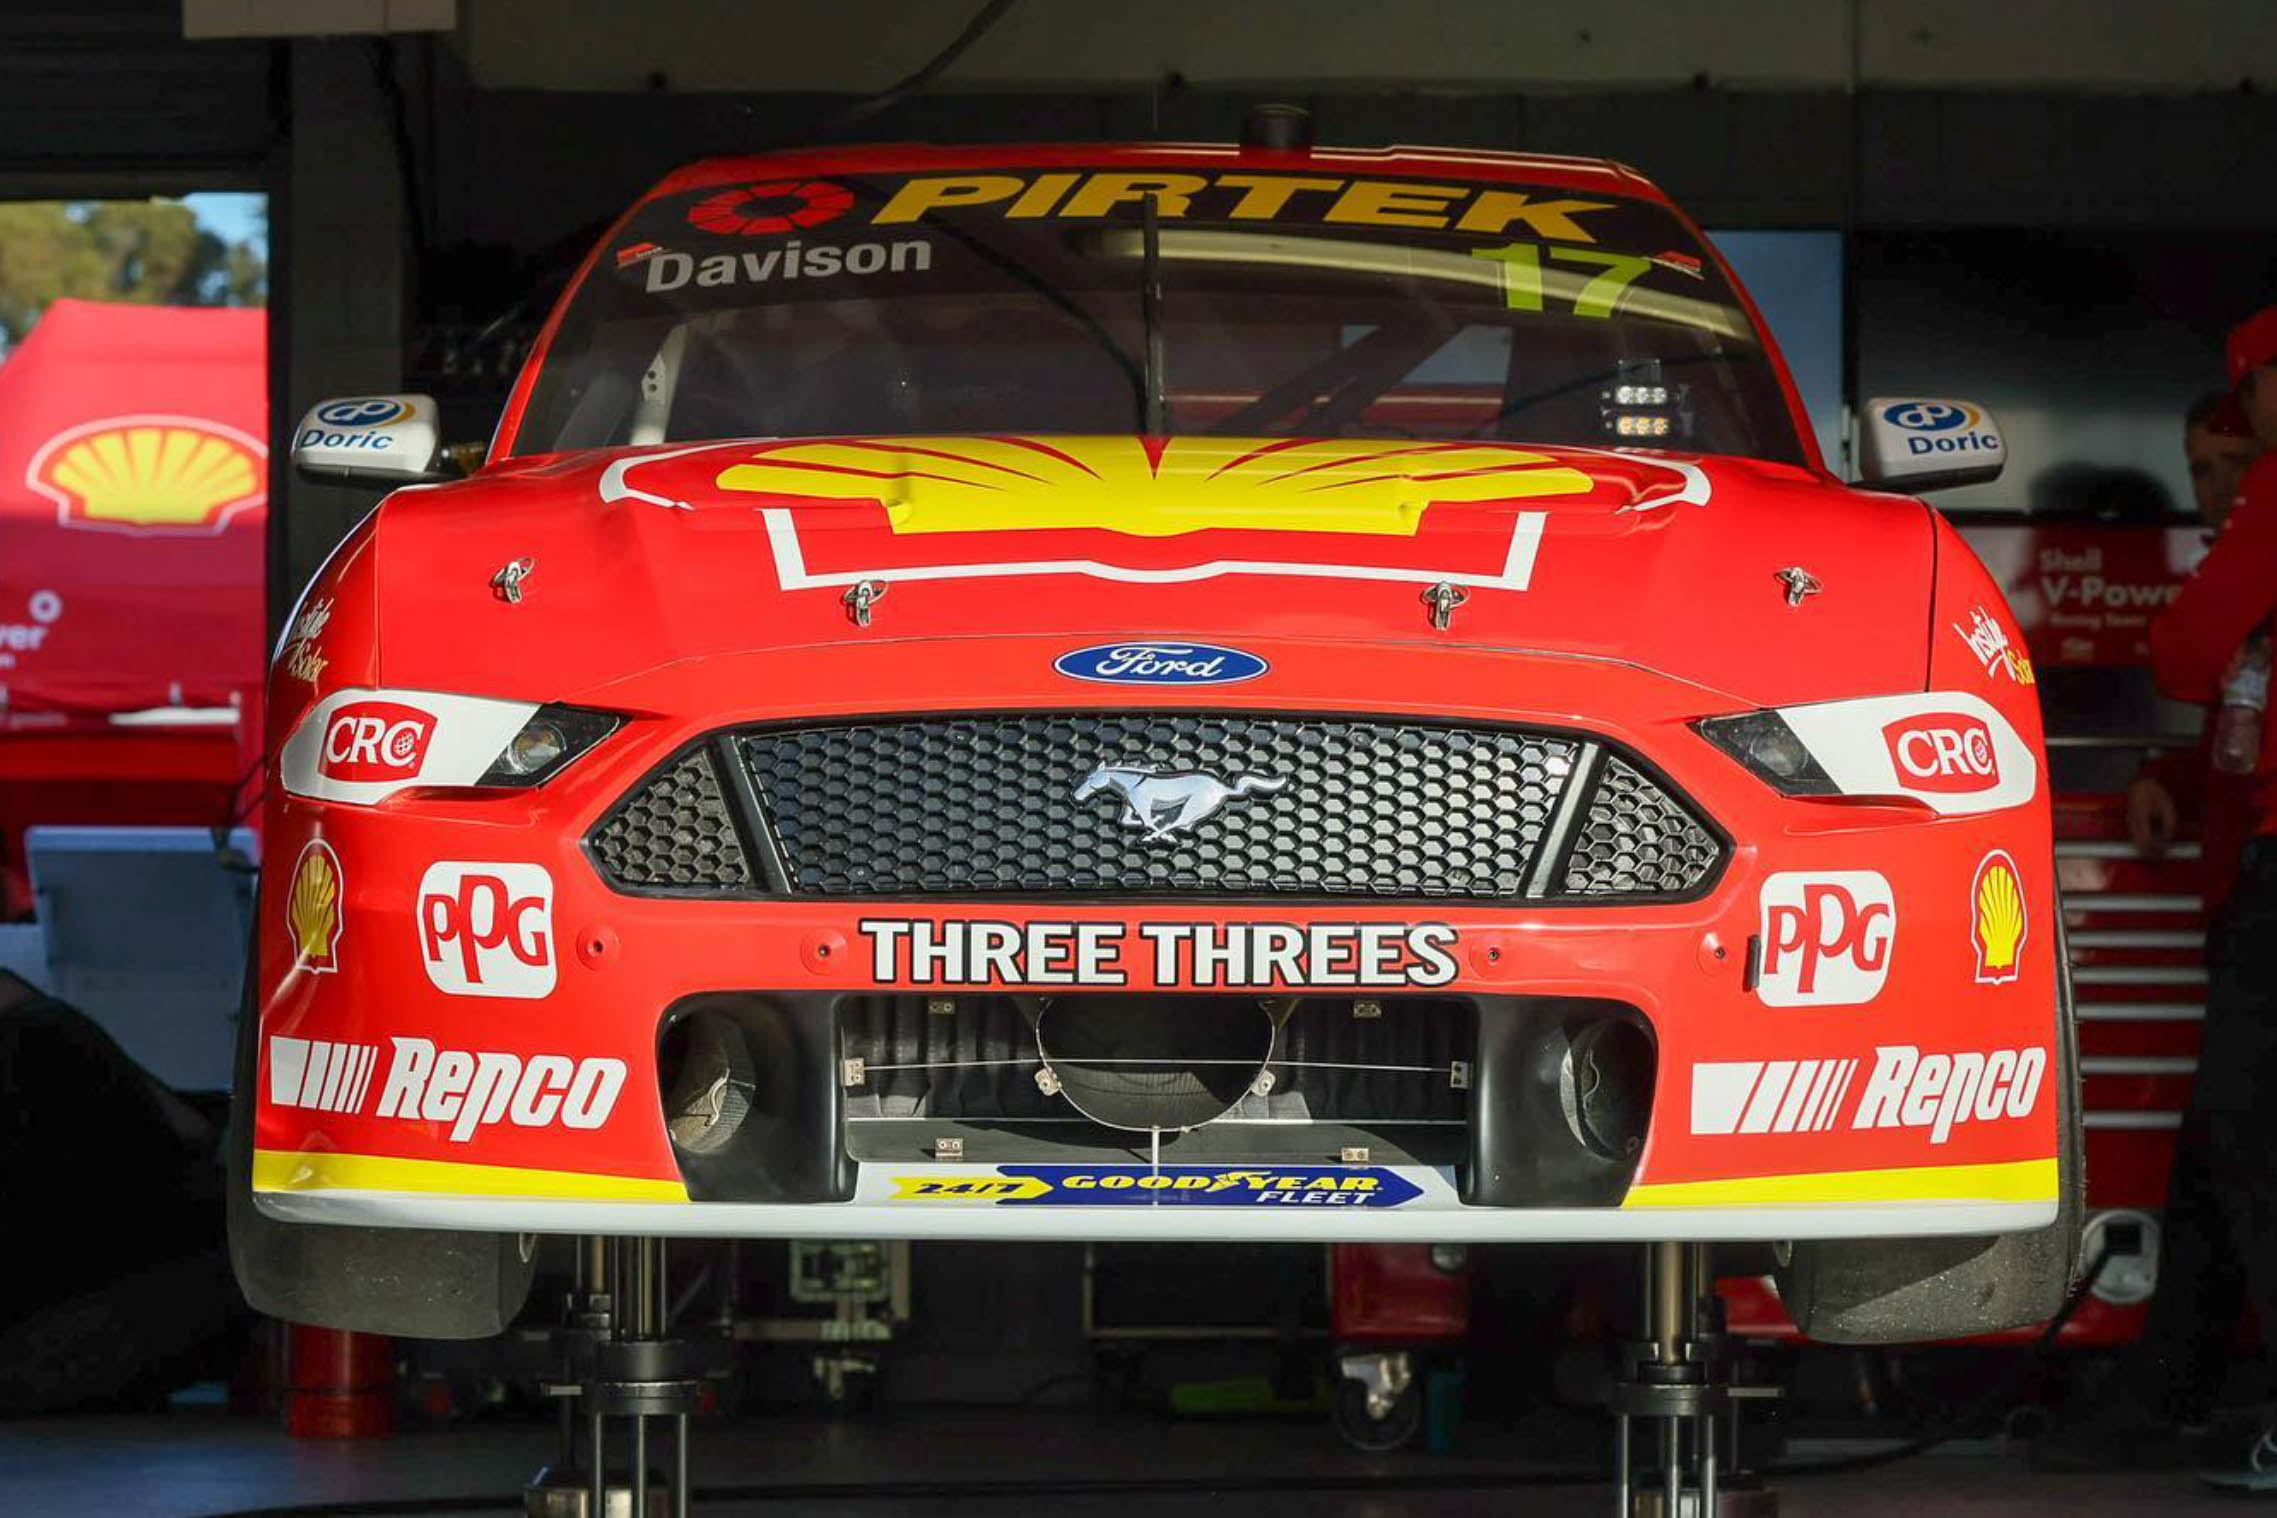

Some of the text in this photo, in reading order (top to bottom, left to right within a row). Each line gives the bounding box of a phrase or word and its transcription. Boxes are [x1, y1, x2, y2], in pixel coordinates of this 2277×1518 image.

[870, 173, 1617, 243] PIRTEK
[646, 240, 931, 293] Davison
[1472, 243, 1652, 318] 17
[301, 430, 393, 450] Doric
[1908, 431, 1999, 455] Doric
[1096, 647, 1225, 677] Ford
[327, 716, 424, 767] CRC
[1898, 727, 1993, 777] CRC
[423, 875, 549, 984] PPG
[860, 918, 1459, 988] THREE THREES
[1764, 883, 1890, 993] PPG
[376, 1036, 627, 1142] Repco
[1851, 1045, 2047, 1144] Repco
[915, 1182, 1024, 1194] 24/7
[1256, 1191, 1375, 1205] FLEET
